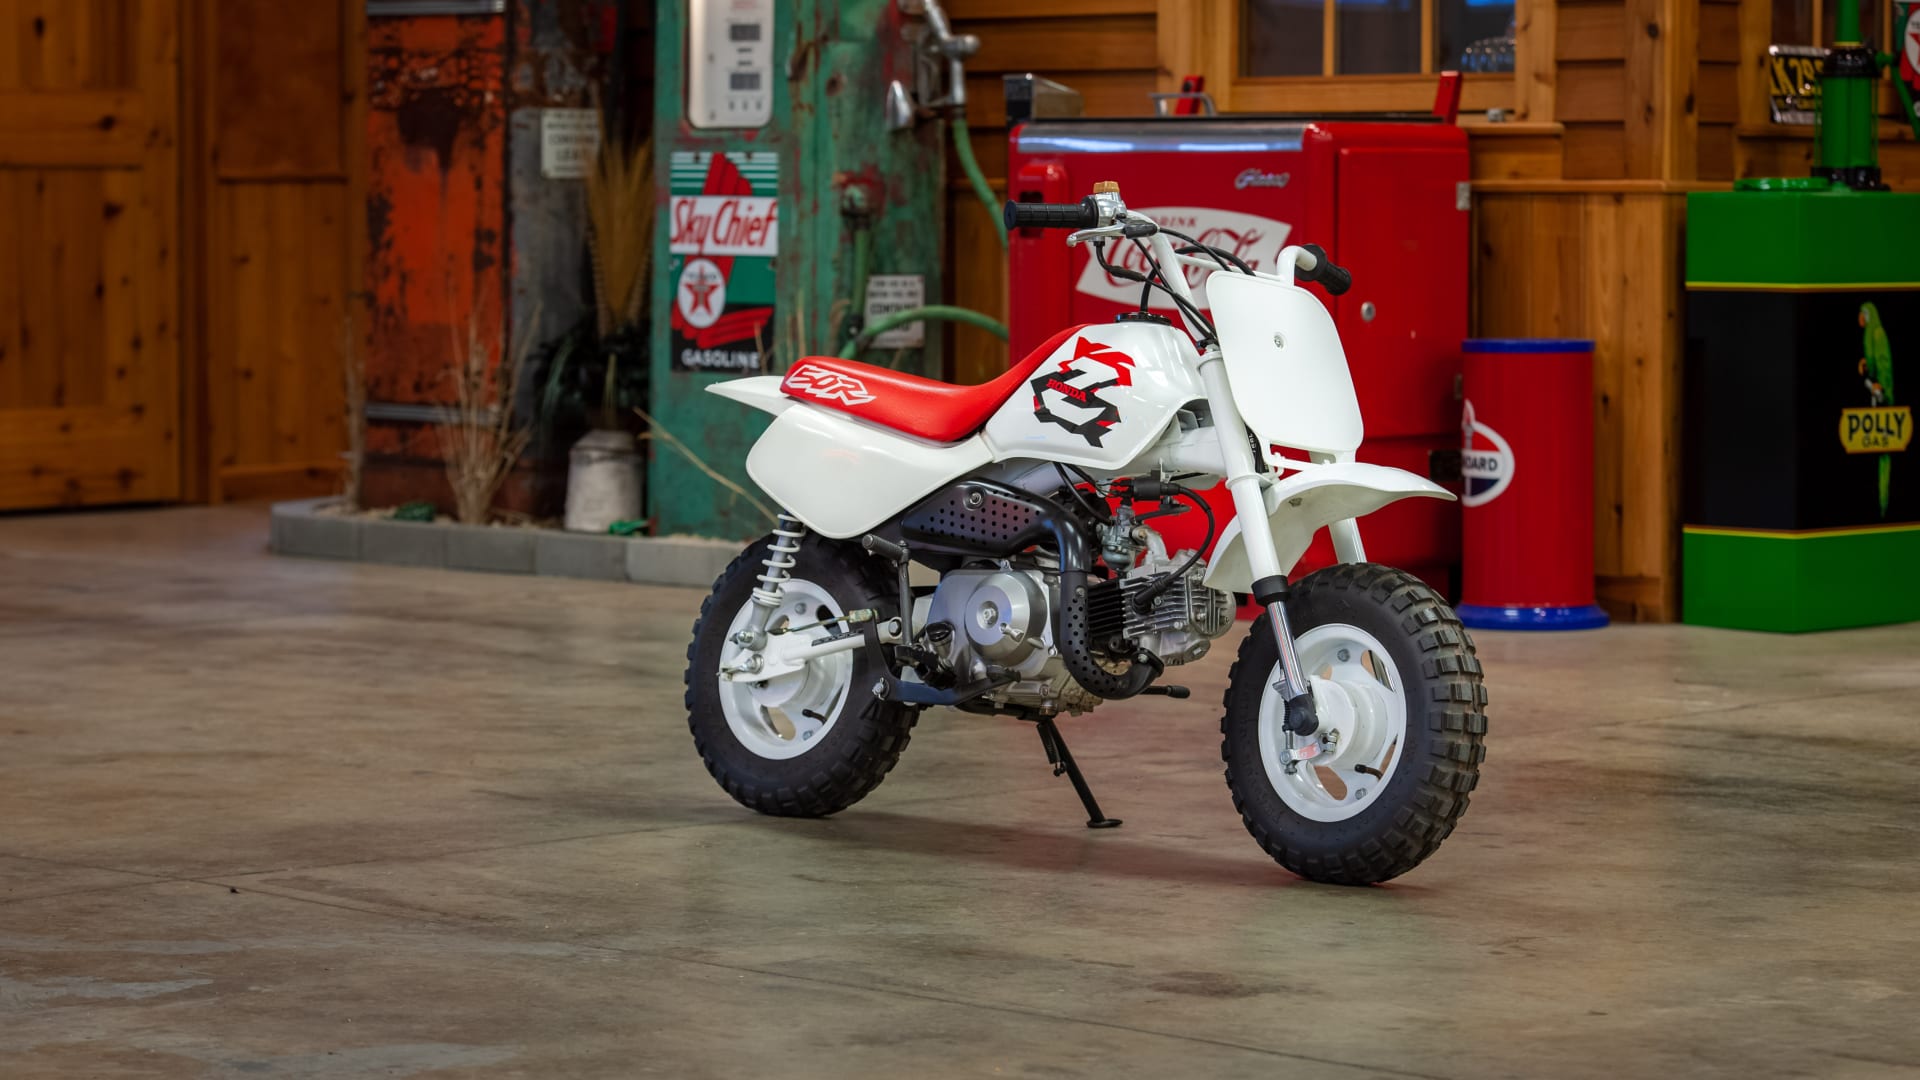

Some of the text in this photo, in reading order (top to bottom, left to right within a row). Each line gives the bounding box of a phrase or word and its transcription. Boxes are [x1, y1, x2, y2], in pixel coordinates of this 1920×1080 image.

[671, 199, 778, 255] Sky Chief
[681, 348, 760, 369] GASOLINE
[1046, 377, 1088, 404] HONDA
[1847, 411, 1906, 442] POLLY
[1862, 436, 1889, 448] GAS
